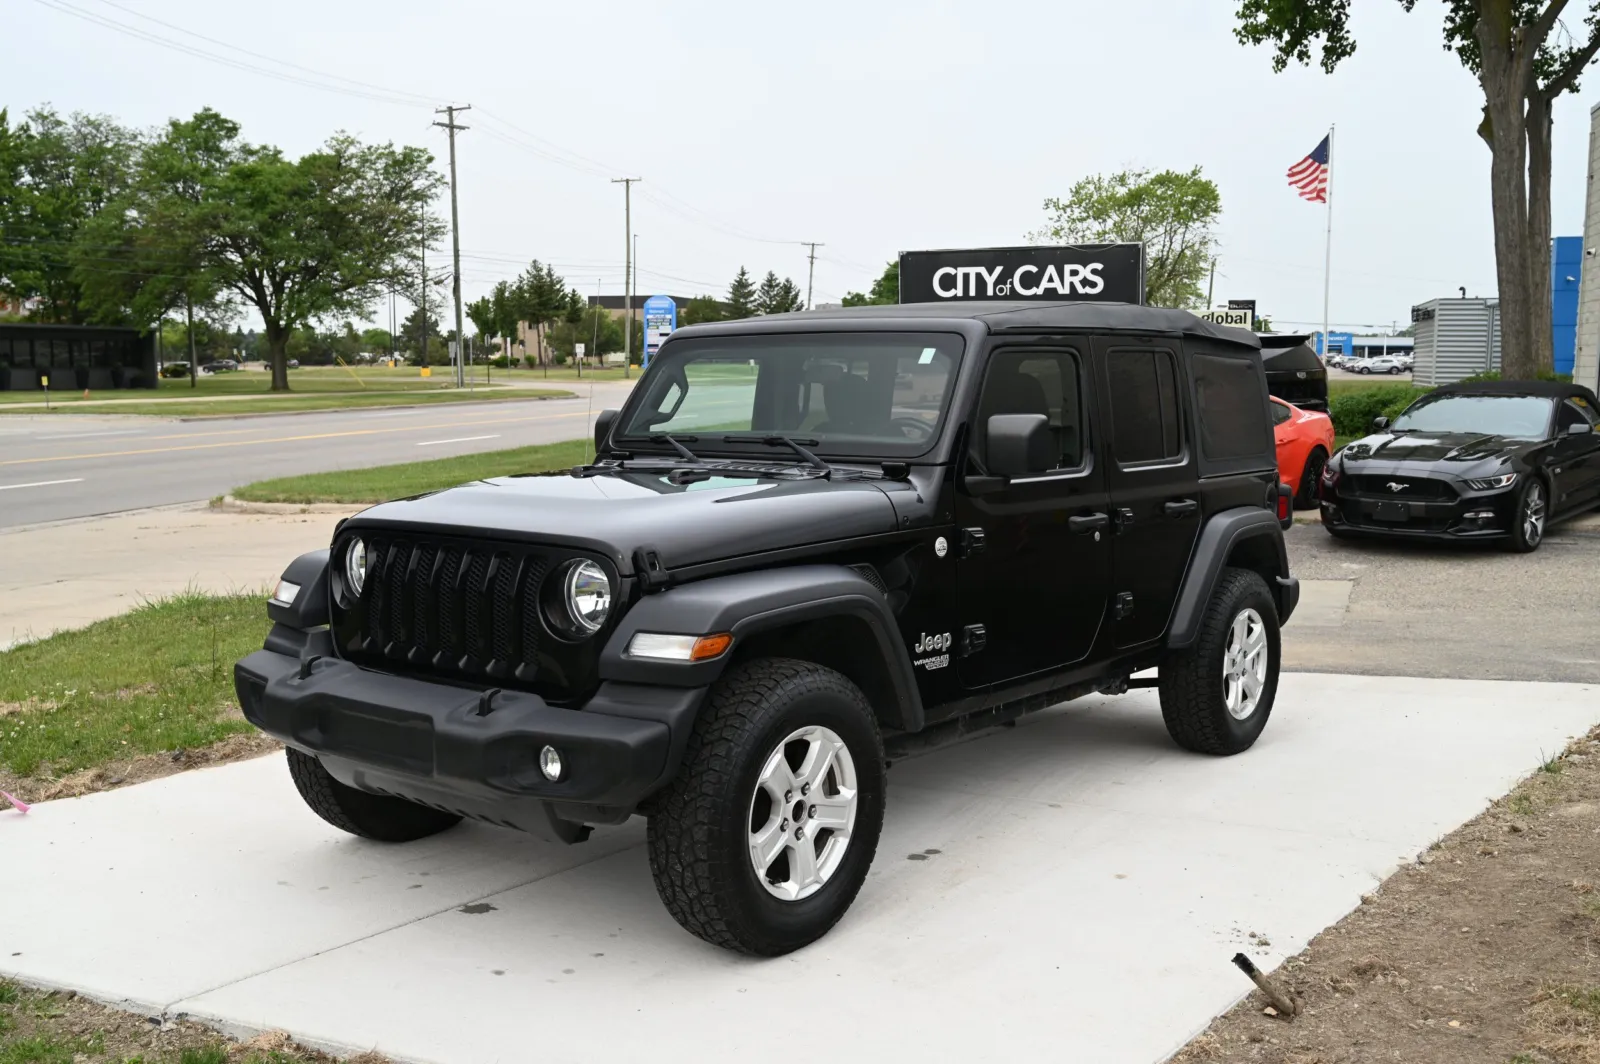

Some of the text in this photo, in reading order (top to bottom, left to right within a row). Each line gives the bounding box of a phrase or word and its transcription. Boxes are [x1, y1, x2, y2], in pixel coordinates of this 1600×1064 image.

[932, 262, 1105, 298] CITY of CARS
[915, 632, 952, 653] Jeep
